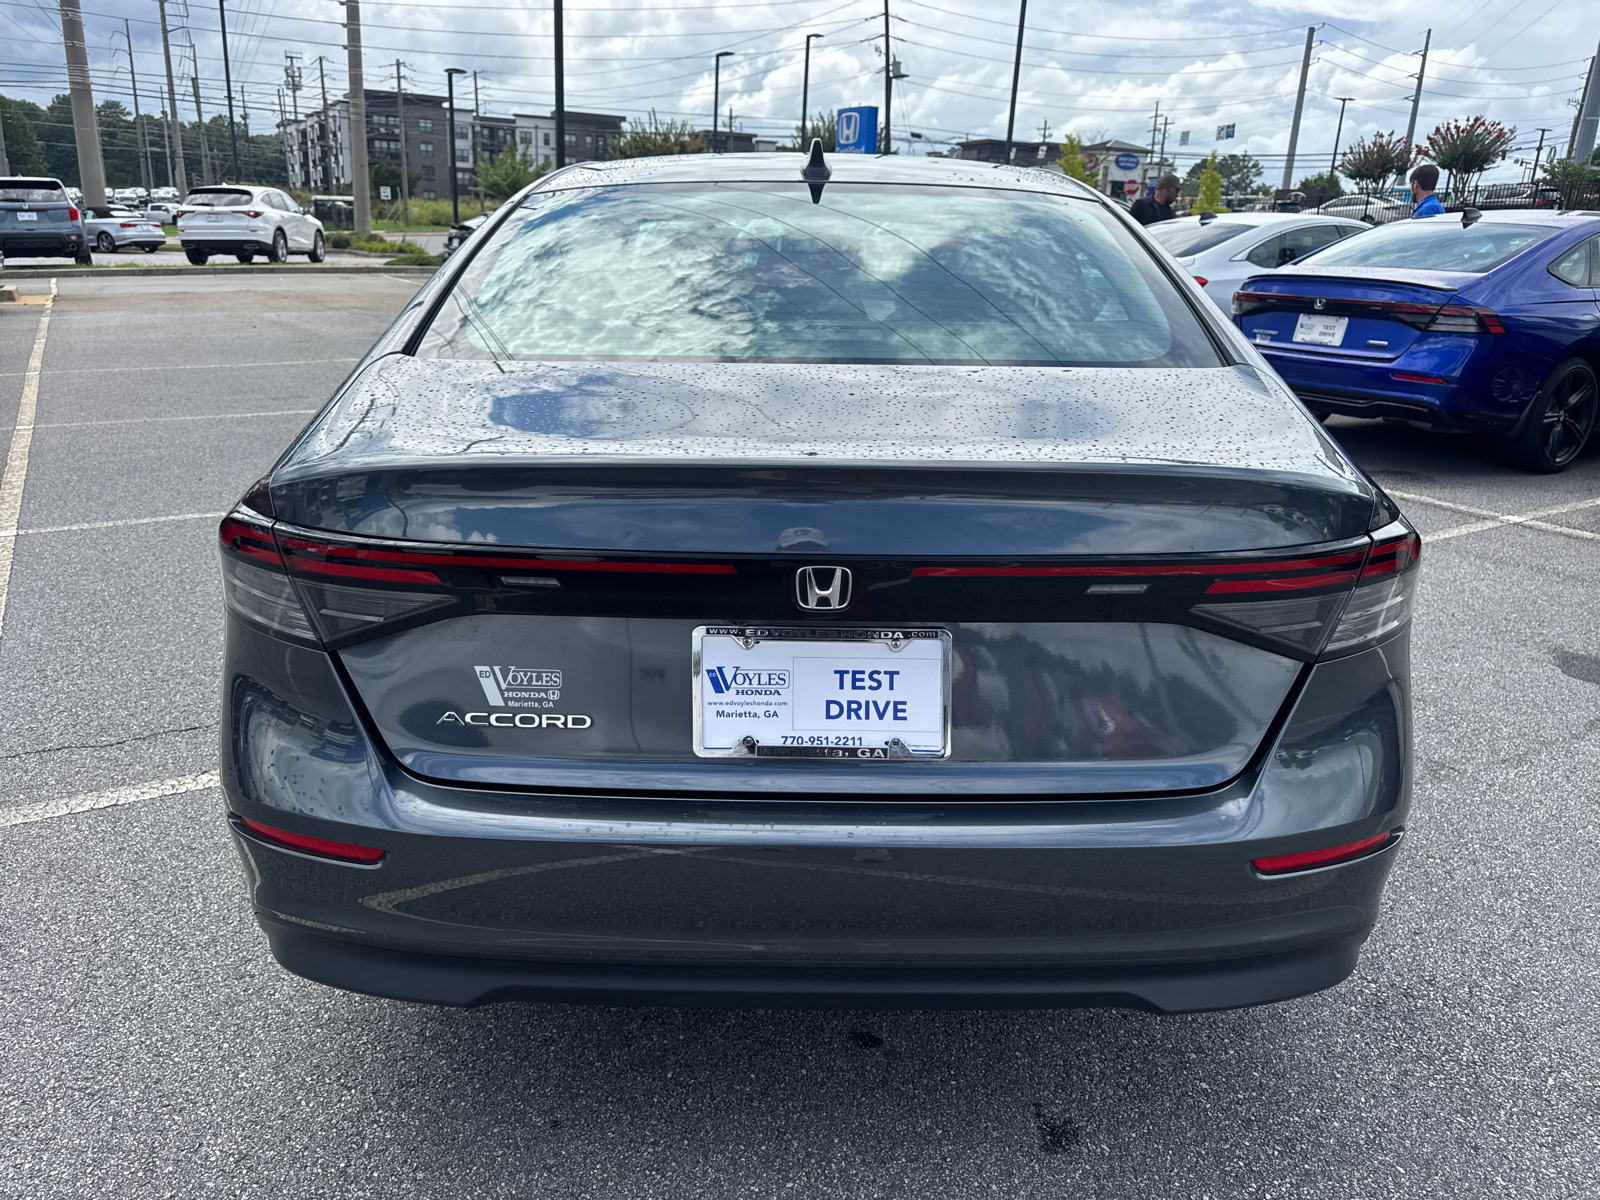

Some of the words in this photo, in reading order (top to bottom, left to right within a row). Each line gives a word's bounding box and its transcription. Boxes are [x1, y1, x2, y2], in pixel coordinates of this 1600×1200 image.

[479, 670, 491, 679] ED
[834, 669, 900, 691] TEST
[503, 691, 547, 699] HONDA
[508, 700, 541, 708] Marietta,
[716, 710, 760, 719] Marietta,
[764, 710, 779, 718] GA
[826, 699, 908, 721] DRIVE
[436, 711, 592, 729] ACCORD
[781, 735, 863, 746] 770-951-2211
[760, 748, 849, 758] Marietta,
[856, 748, 885, 758] GA
